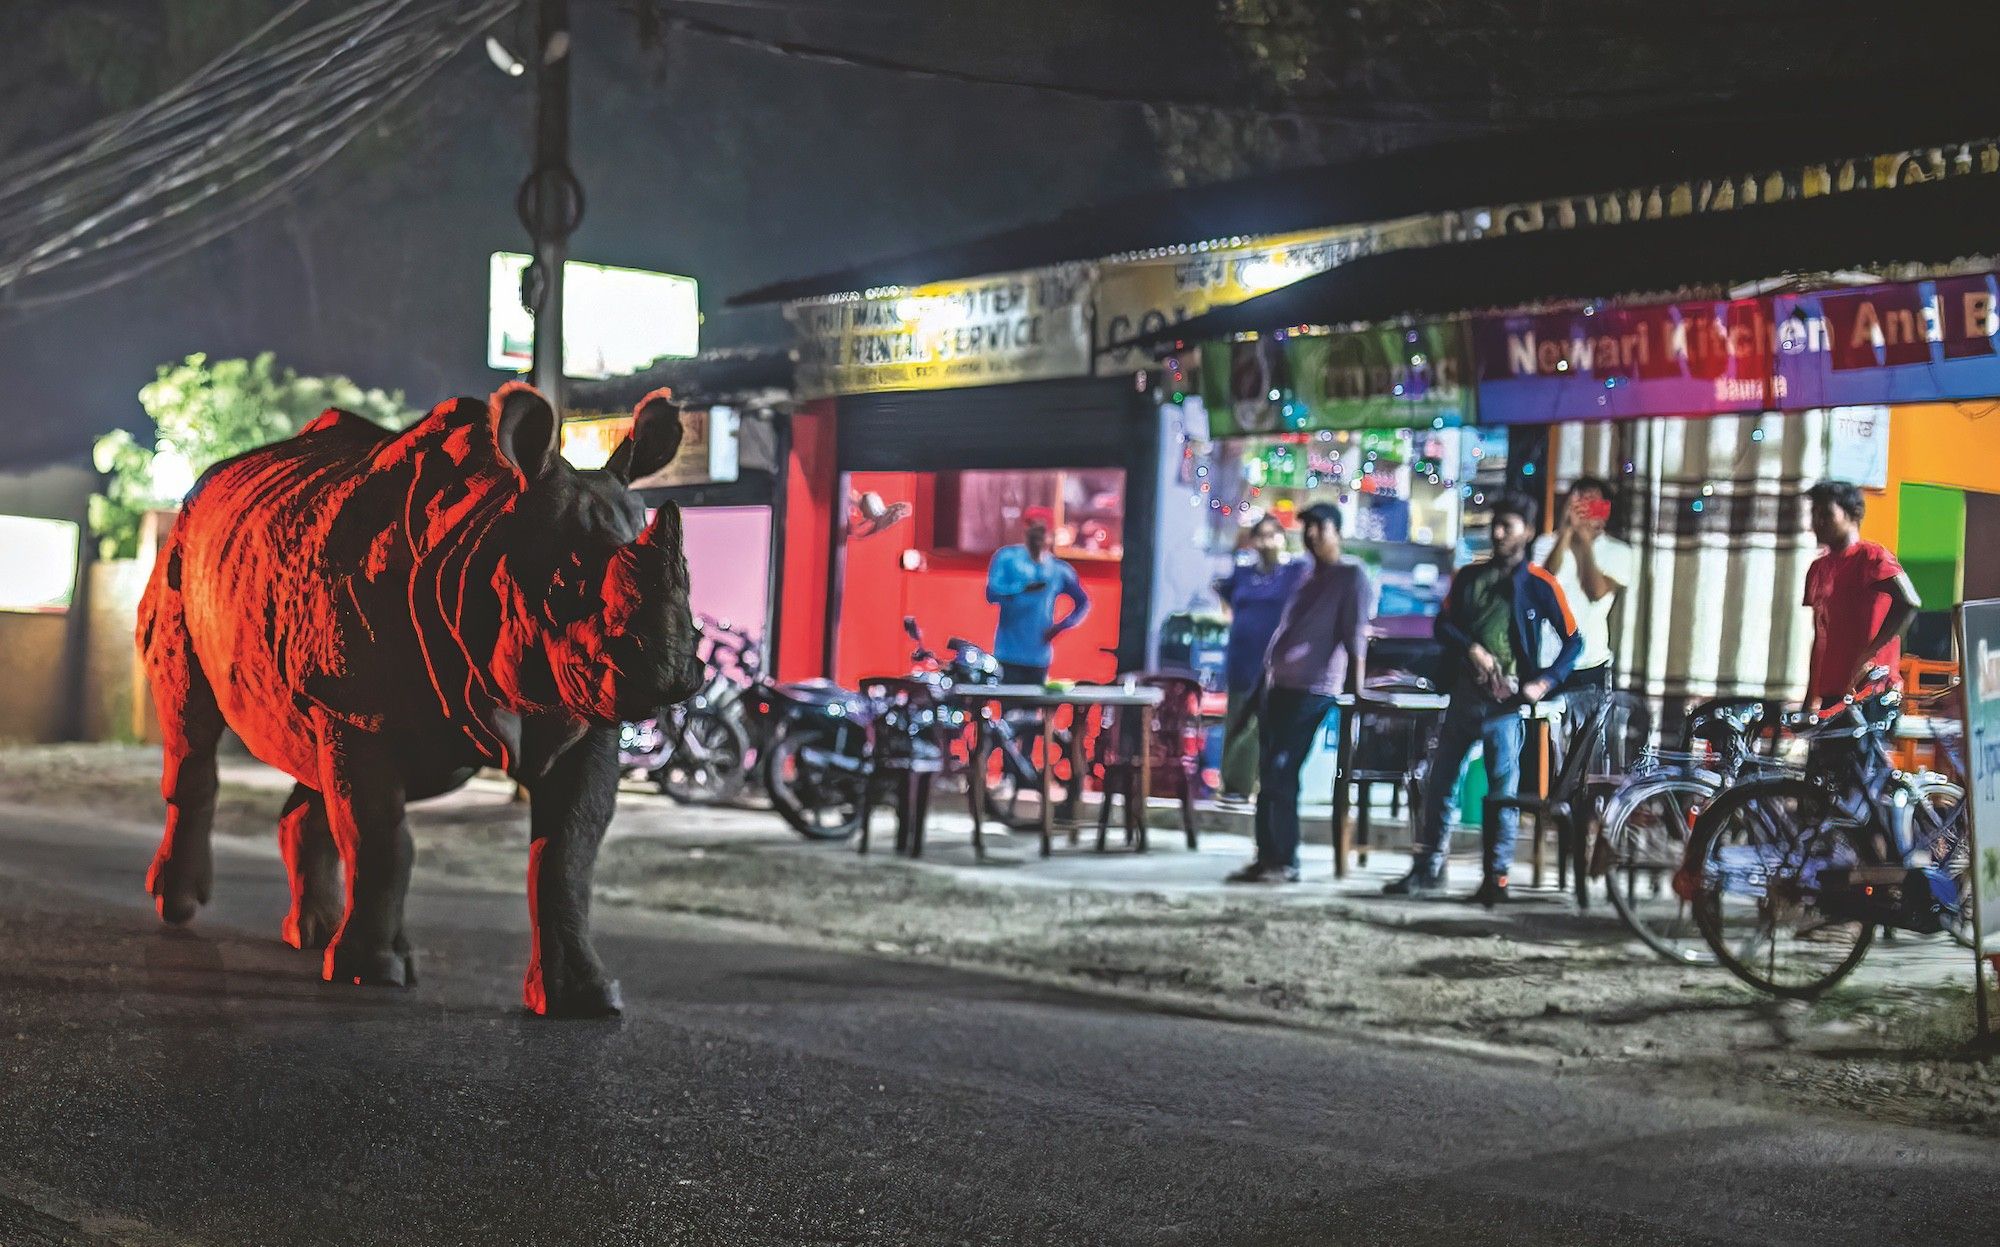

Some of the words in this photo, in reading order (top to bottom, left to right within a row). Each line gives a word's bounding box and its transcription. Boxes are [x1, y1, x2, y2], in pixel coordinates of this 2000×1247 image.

[938, 314, 1042, 358] SERVICE
[1507, 321, 1649, 375] Newari
[1662, 311, 1834, 362] Kitchen
[1850, 294, 1945, 348] And
